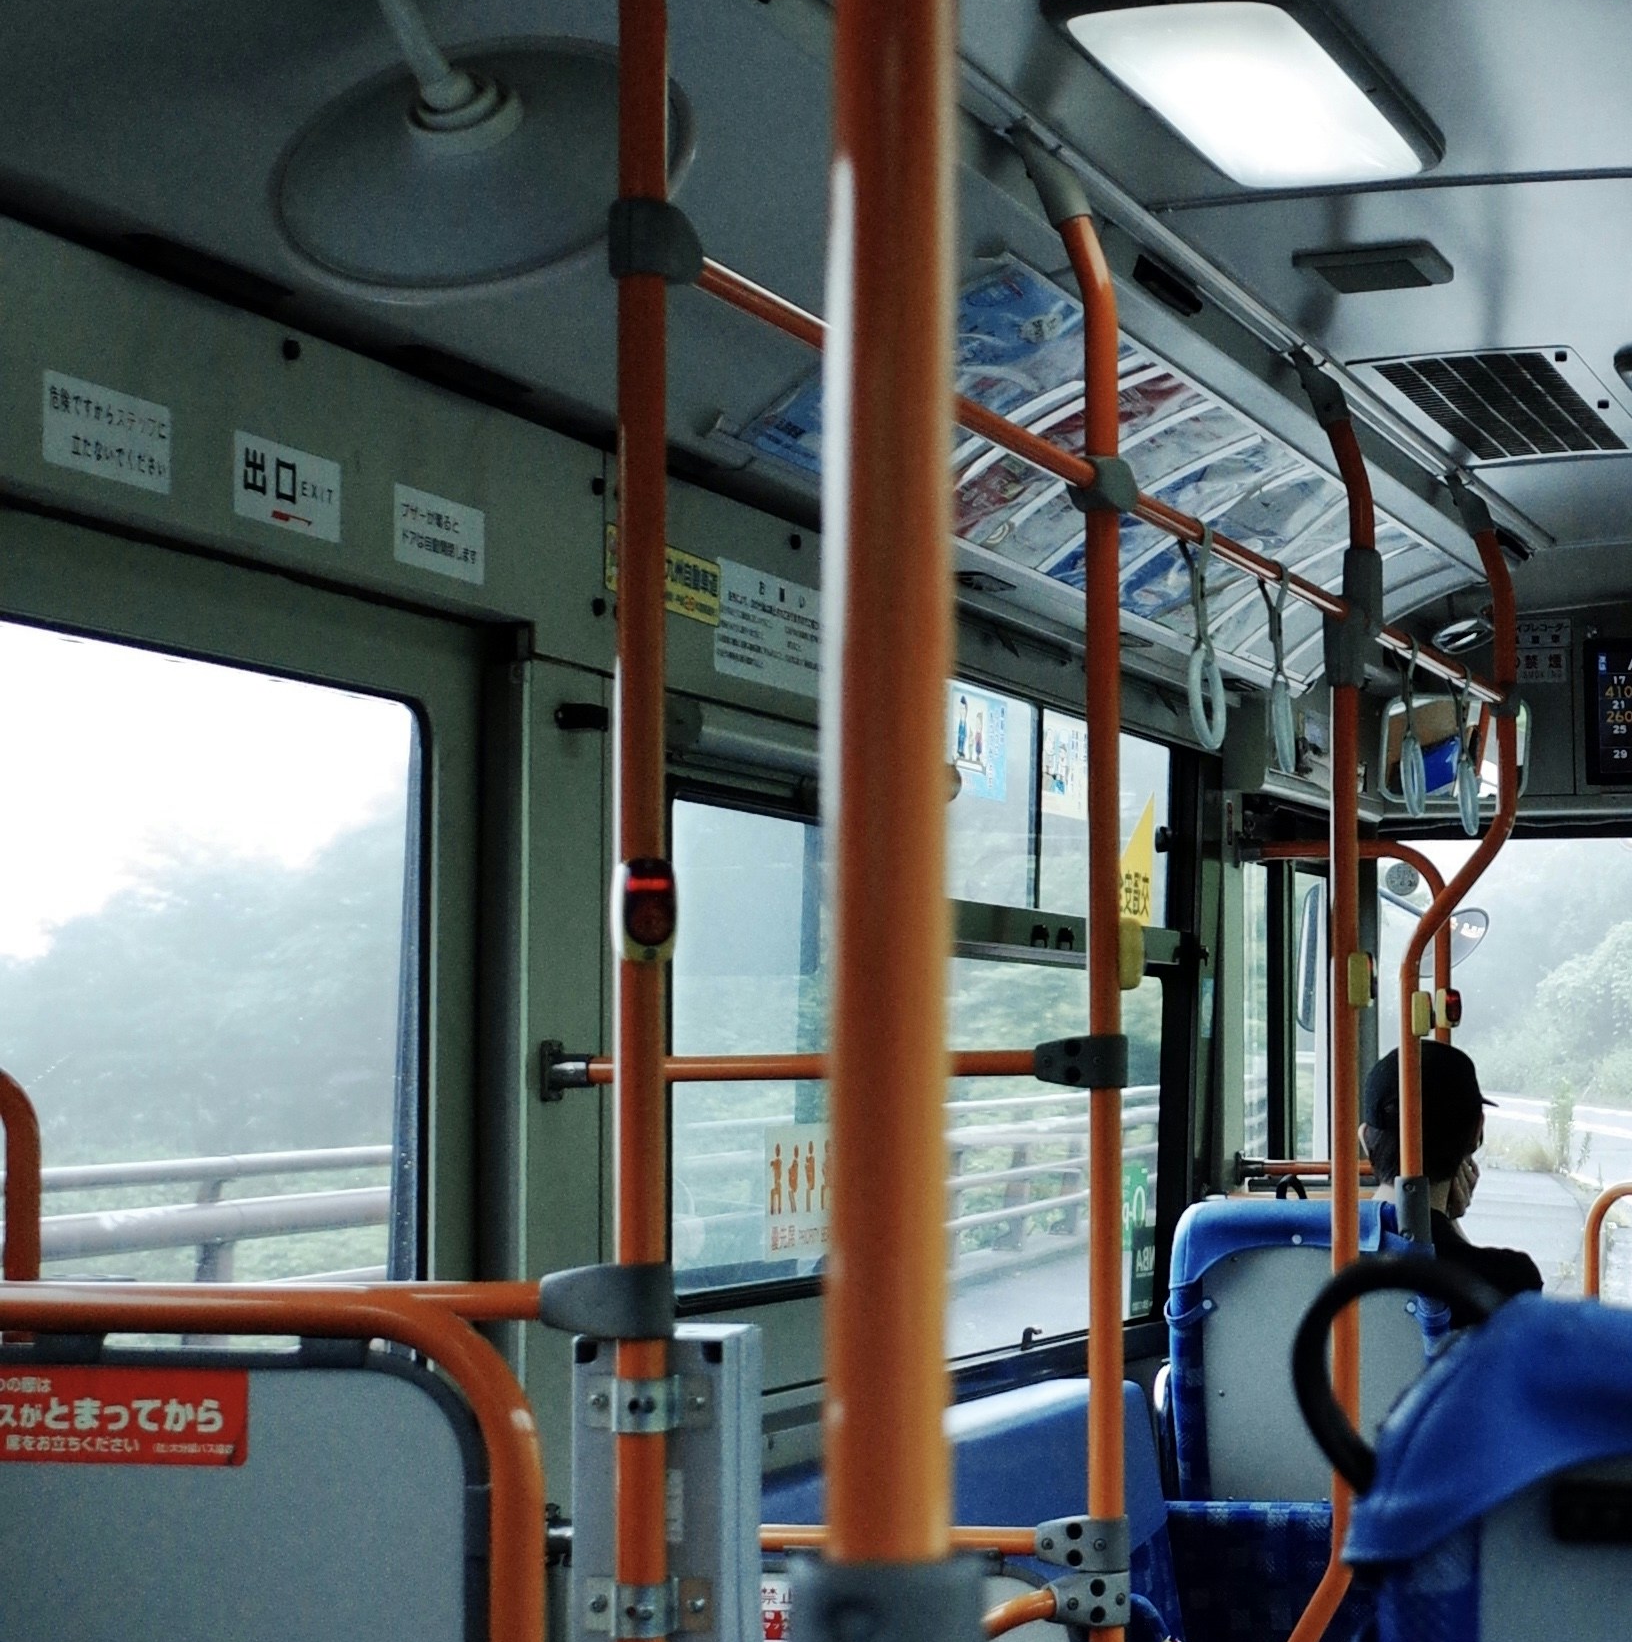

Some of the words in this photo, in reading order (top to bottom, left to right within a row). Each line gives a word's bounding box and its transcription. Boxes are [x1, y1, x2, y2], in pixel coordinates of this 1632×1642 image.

[243, 447, 296, 505] 出口
[301, 480, 334, 505] EXIT
[1517, 623, 1569, 633] イブレコーダー
[1613, 676, 1626, 685] 17
[1605, 685, 1632, 698] 410
[1612, 700, 1625, 709] 21
[1613, 725, 1627, 734] 25
[1613, 750, 1628, 759] 29
[0, 1397, 223, 1433] スがとまってから
